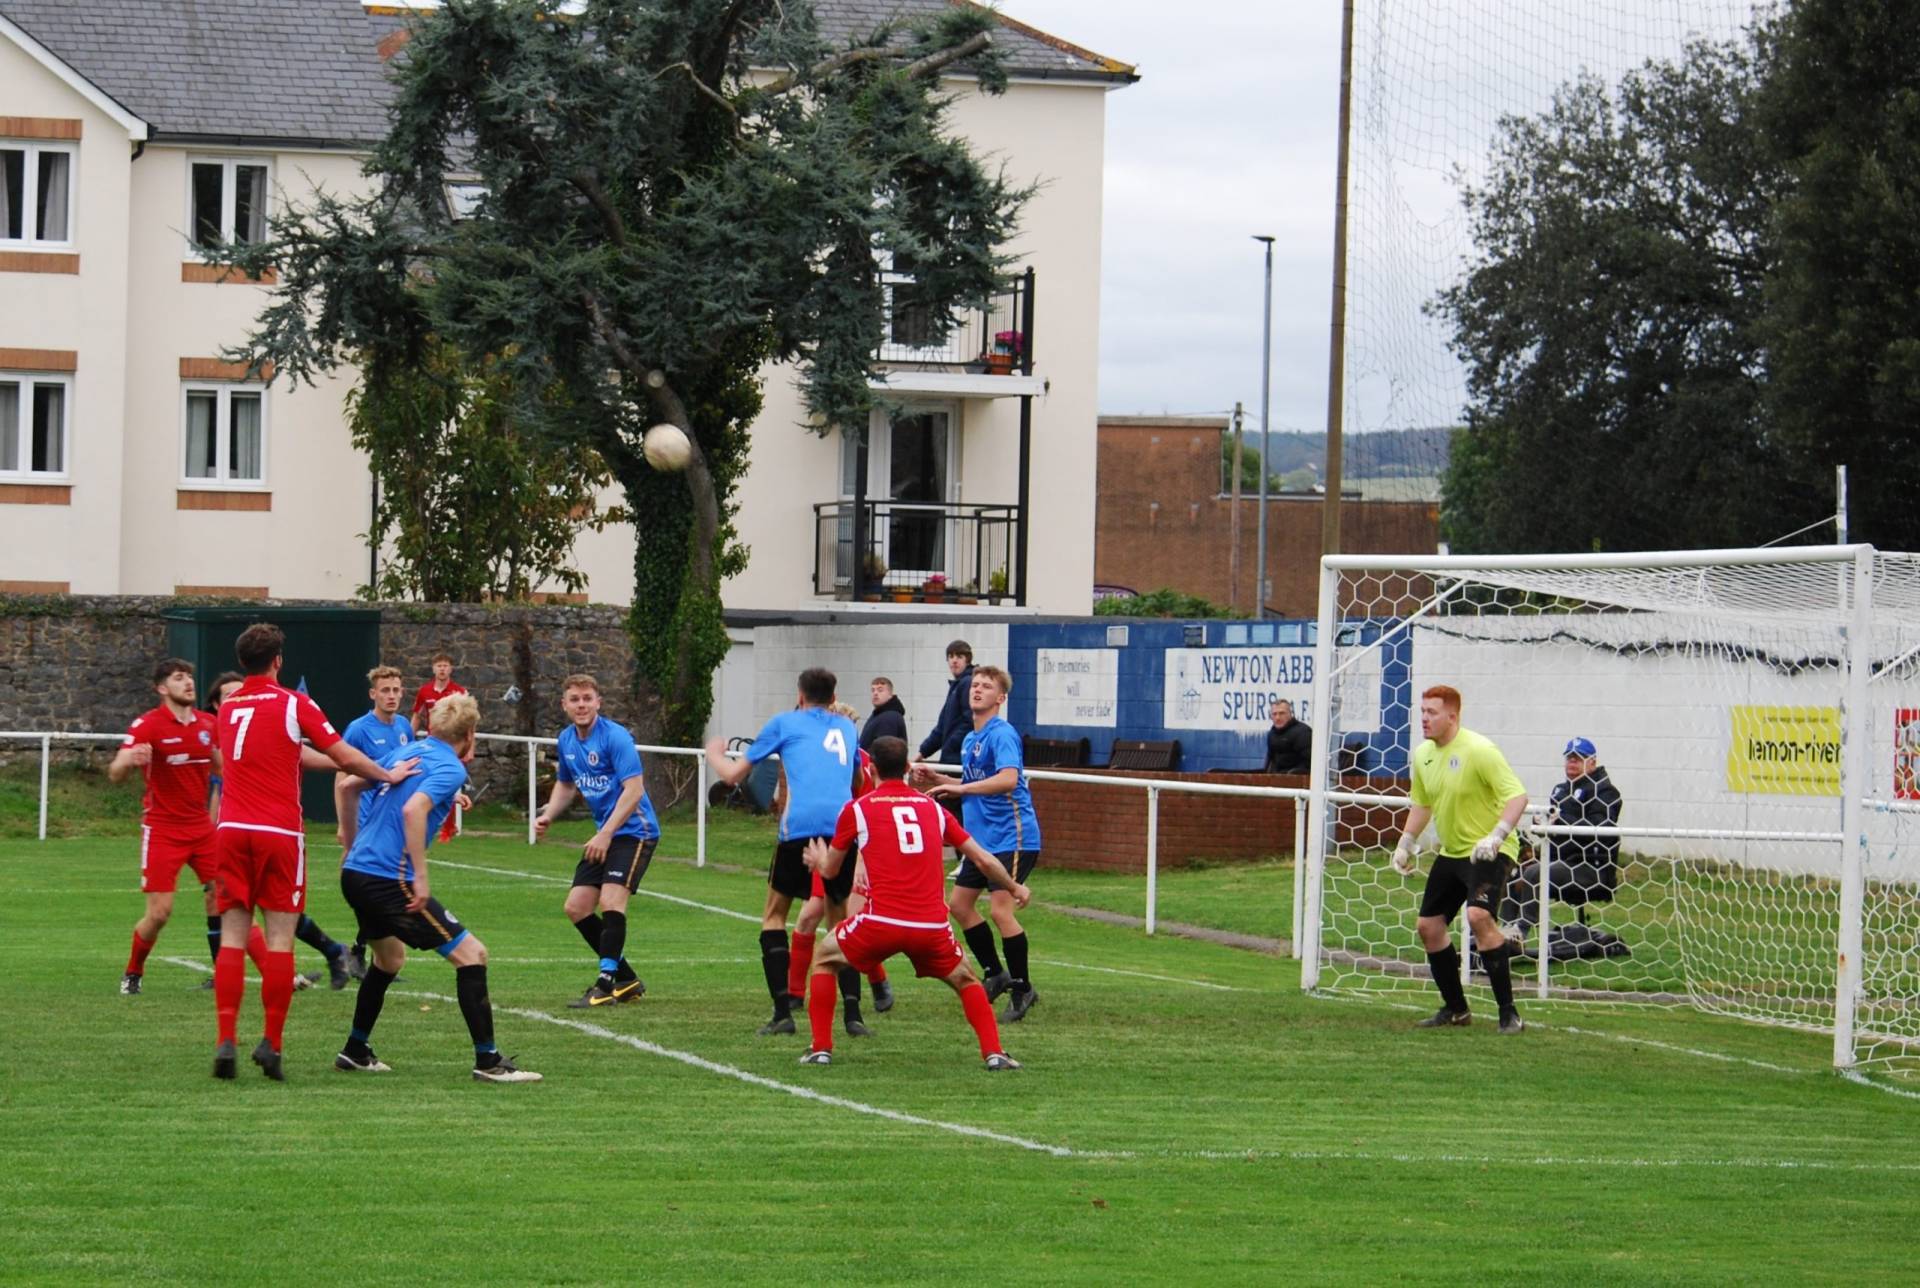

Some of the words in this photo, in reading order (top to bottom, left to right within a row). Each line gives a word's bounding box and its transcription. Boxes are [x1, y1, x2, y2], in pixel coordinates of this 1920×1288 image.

[1201, 654, 1273, 684] NEWTON
[1276, 654, 1314, 684] ABB
[1223, 691, 1278, 720] SPURS
[229, 707, 255, 760] 7
[823, 728, 847, 766] 4
[892, 806, 924, 854] 6
